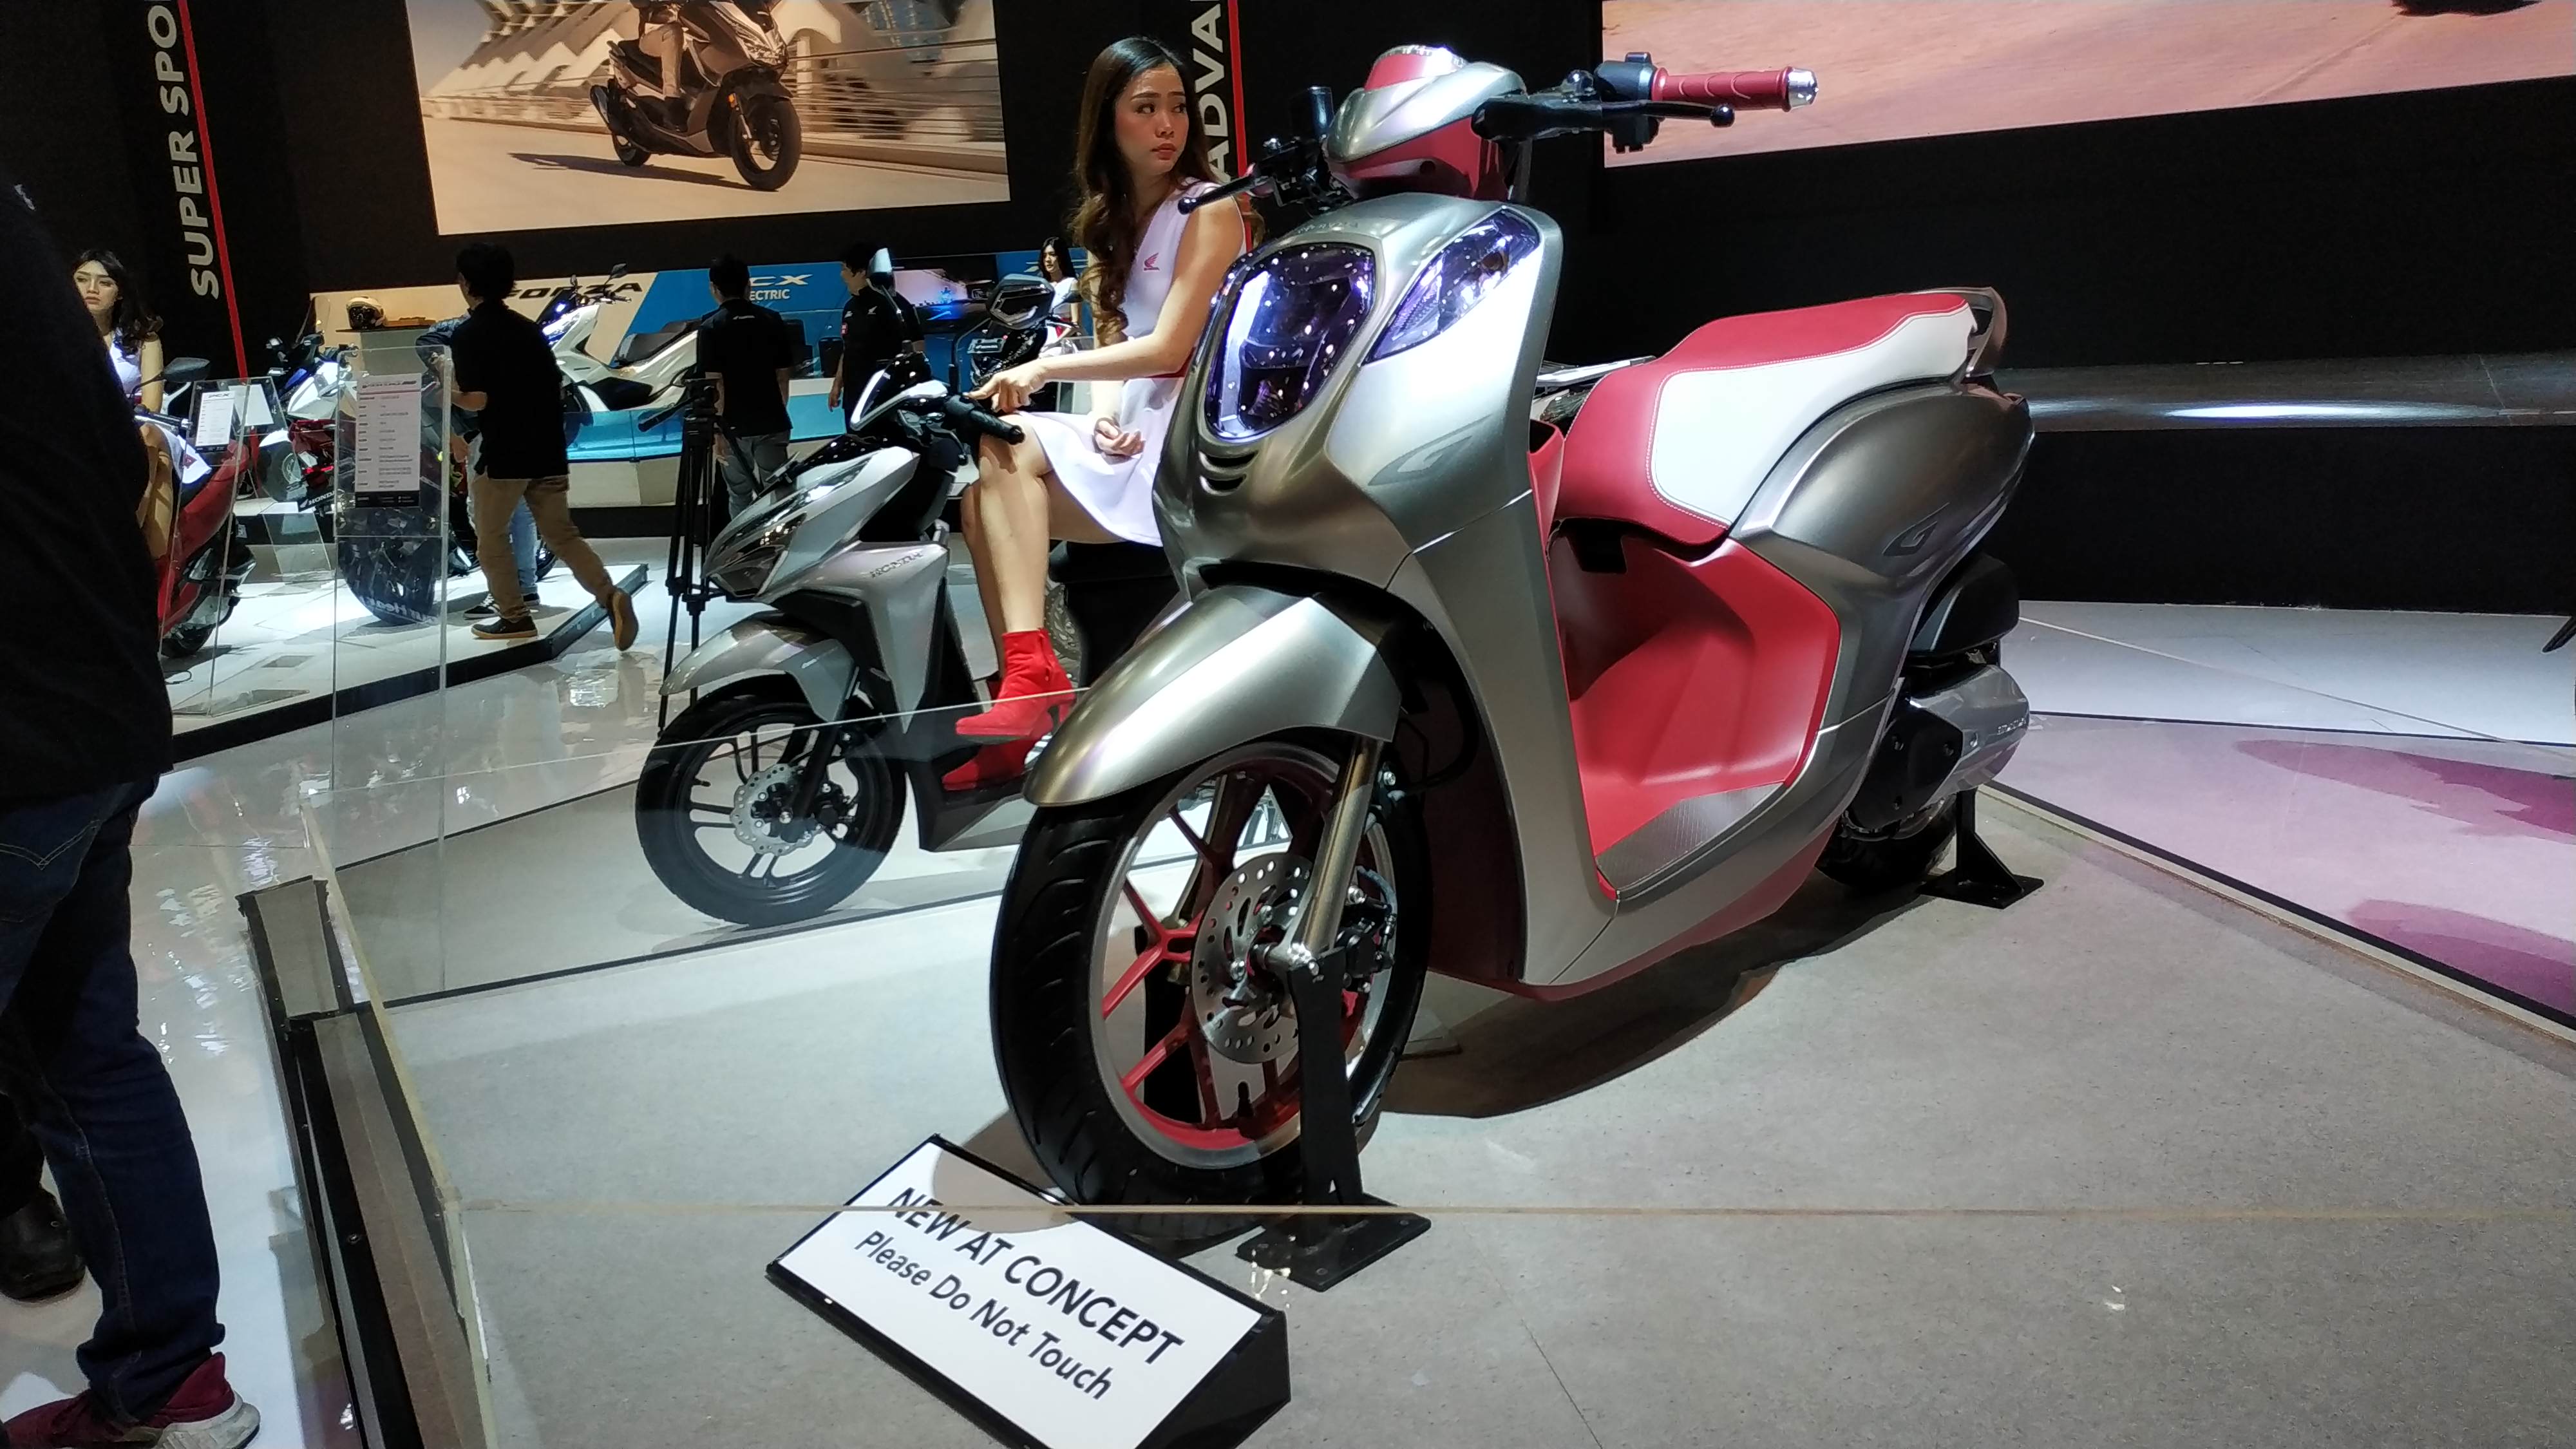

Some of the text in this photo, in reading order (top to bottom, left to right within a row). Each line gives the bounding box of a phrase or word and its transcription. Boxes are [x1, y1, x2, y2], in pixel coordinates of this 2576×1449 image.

[147, 0, 219, 299] SUPER SPO
[1190, 0, 1231, 184] ADVA
[749, 274, 813, 287] CX
[749, 289, 790, 301] ECTRIC
[854, 1230, 1113, 1400] Please Do Not Touch
[887, 1187, 1186, 1365] NEW AT CONCEPT
